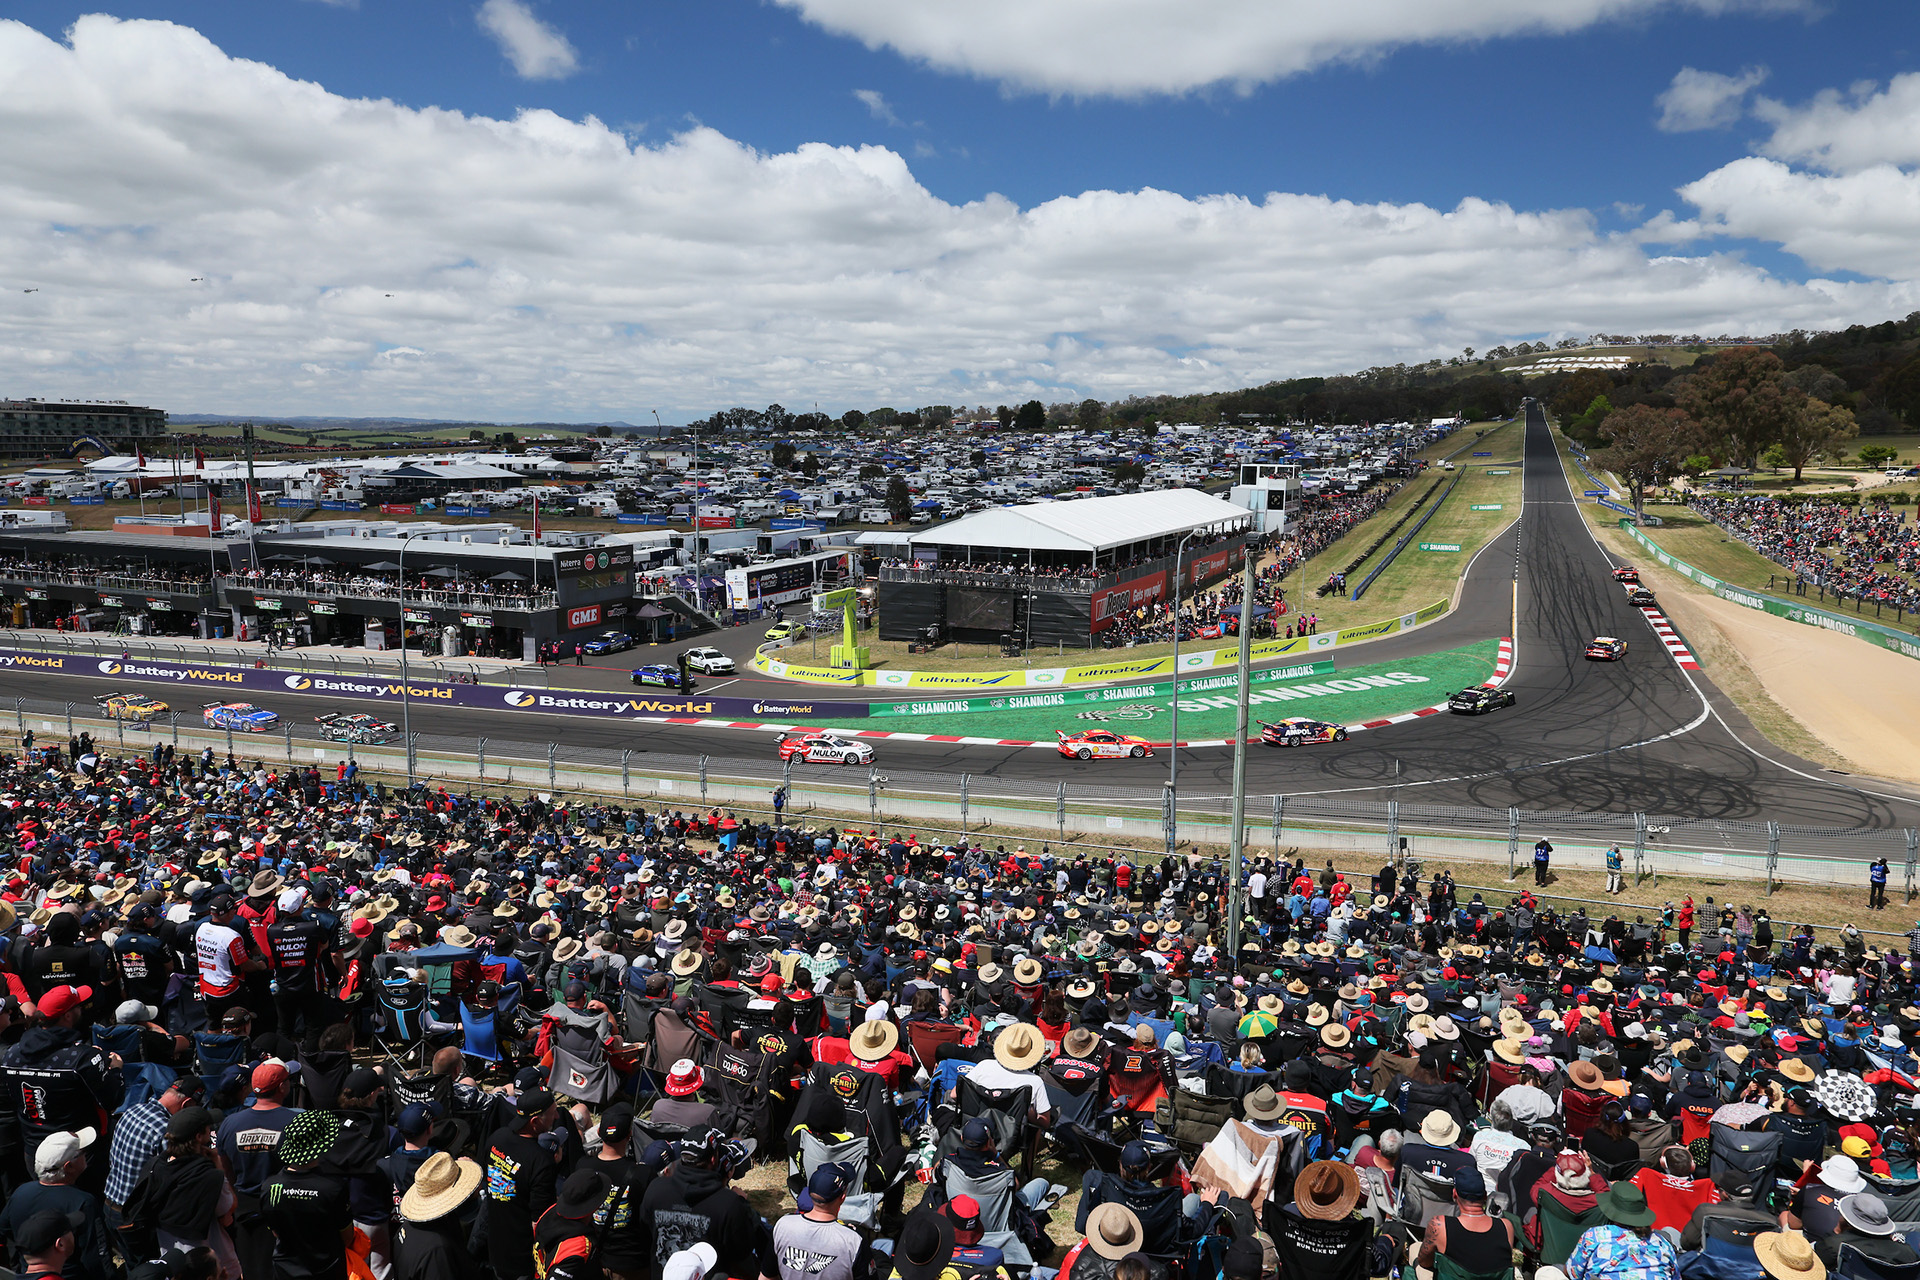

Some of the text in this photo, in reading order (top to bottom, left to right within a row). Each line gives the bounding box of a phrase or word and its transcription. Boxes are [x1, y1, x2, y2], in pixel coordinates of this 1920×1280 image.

[1536, 356, 1631, 364] MOUNT
[1500, 363, 1632, 372] PANORAM
[1429, 544, 1460, 552] SHANNONS
[560, 559, 581, 568] Niterra
[1106, 588, 1131, 617] Repco
[1133, 588, 1143, 602] Gets
[1144, 586, 1152, 600] you
[1726, 589, 1764, 609] SHANNONS
[572, 608, 597, 625] GME
[1804, 612, 1856, 636] SHANNONS
[1342, 628, 1381, 640] ultimate
[1225, 646, 1278, 659] ulate
[124, 664, 243, 682] BatteryWorld
[792, 670, 841, 678] ultimate
[1078, 666, 1141, 677] ultimate
[1270, 664, 1314, 680] SHANNONS
[314, 679, 453, 699] BatteryWorld
[1190, 676, 1239, 691] SHANNONS
[1103, 685, 1156, 700] SHANNONS
[1167, 671, 1430, 712] SHANNONS
[539, 695, 712, 713] BatteryWorld
[1009, 693, 1065, 708] SHANNONS
[764, 705, 812, 714] BatteryWorld
[911, 700, 969, 714] SHANNONS
[1285, 728, 1311, 736] AMPOL
[812, 749, 844, 758] NULON
[197, 943, 218, 954] NULON
[276, 942, 308, 952] NULON
[757, 1036, 788, 1053] PENRITE
[1054, 1058, 1100, 1073] BROWN
[1127, 1057, 1141, 1067] 2
[1688, 1104, 1714, 1114] OAGS
[1484, 1144, 1503, 1155] Team
[1426, 1159, 1447, 1168] FORD
[282, 1188, 319, 1197] MONSTER
[1294, 1228, 1341, 1243] OUTDOORS
[1312, 1246, 1327, 1254] LIKE
